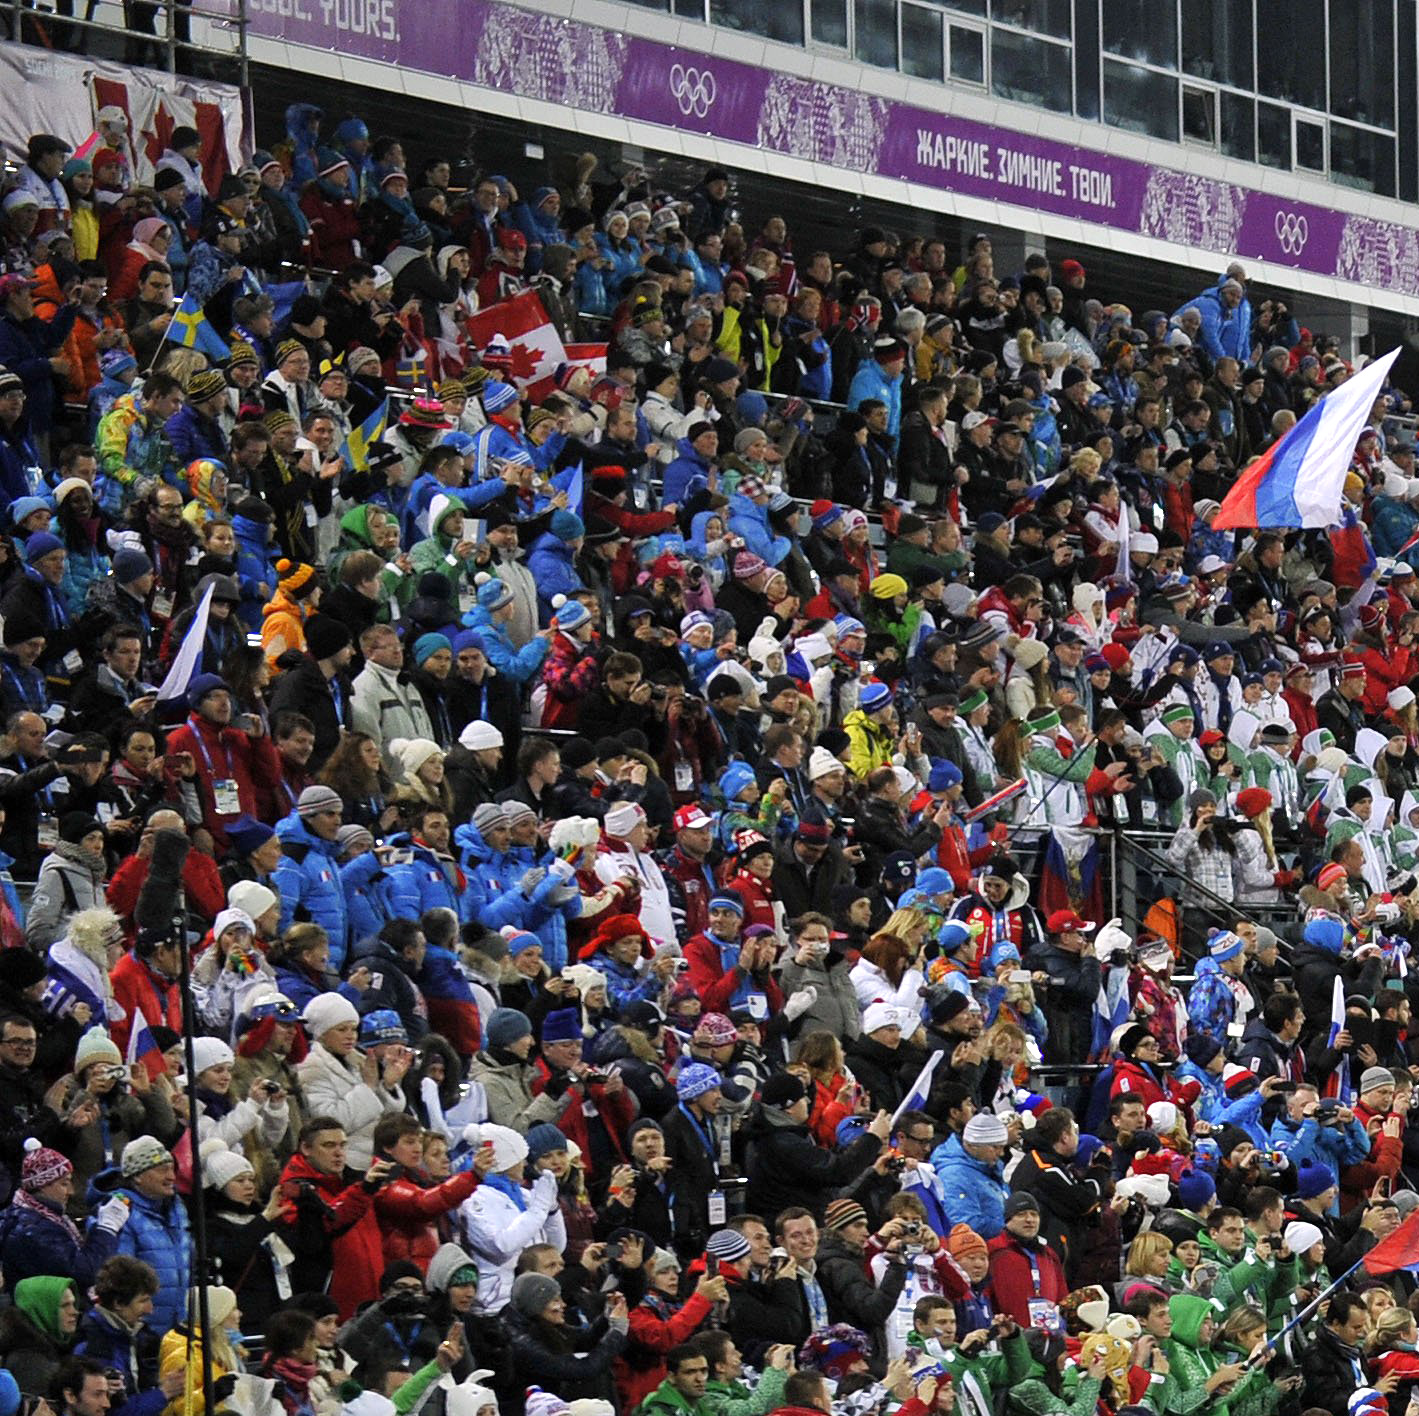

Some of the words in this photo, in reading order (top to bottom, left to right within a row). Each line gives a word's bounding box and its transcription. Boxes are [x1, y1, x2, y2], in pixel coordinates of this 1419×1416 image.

[917, 128, 994, 180] ЖАРКИЕ.
[997, 148, 1066, 197] ЗИМНИЕ.
[1069, 165, 1116, 208] ТВОИ.
